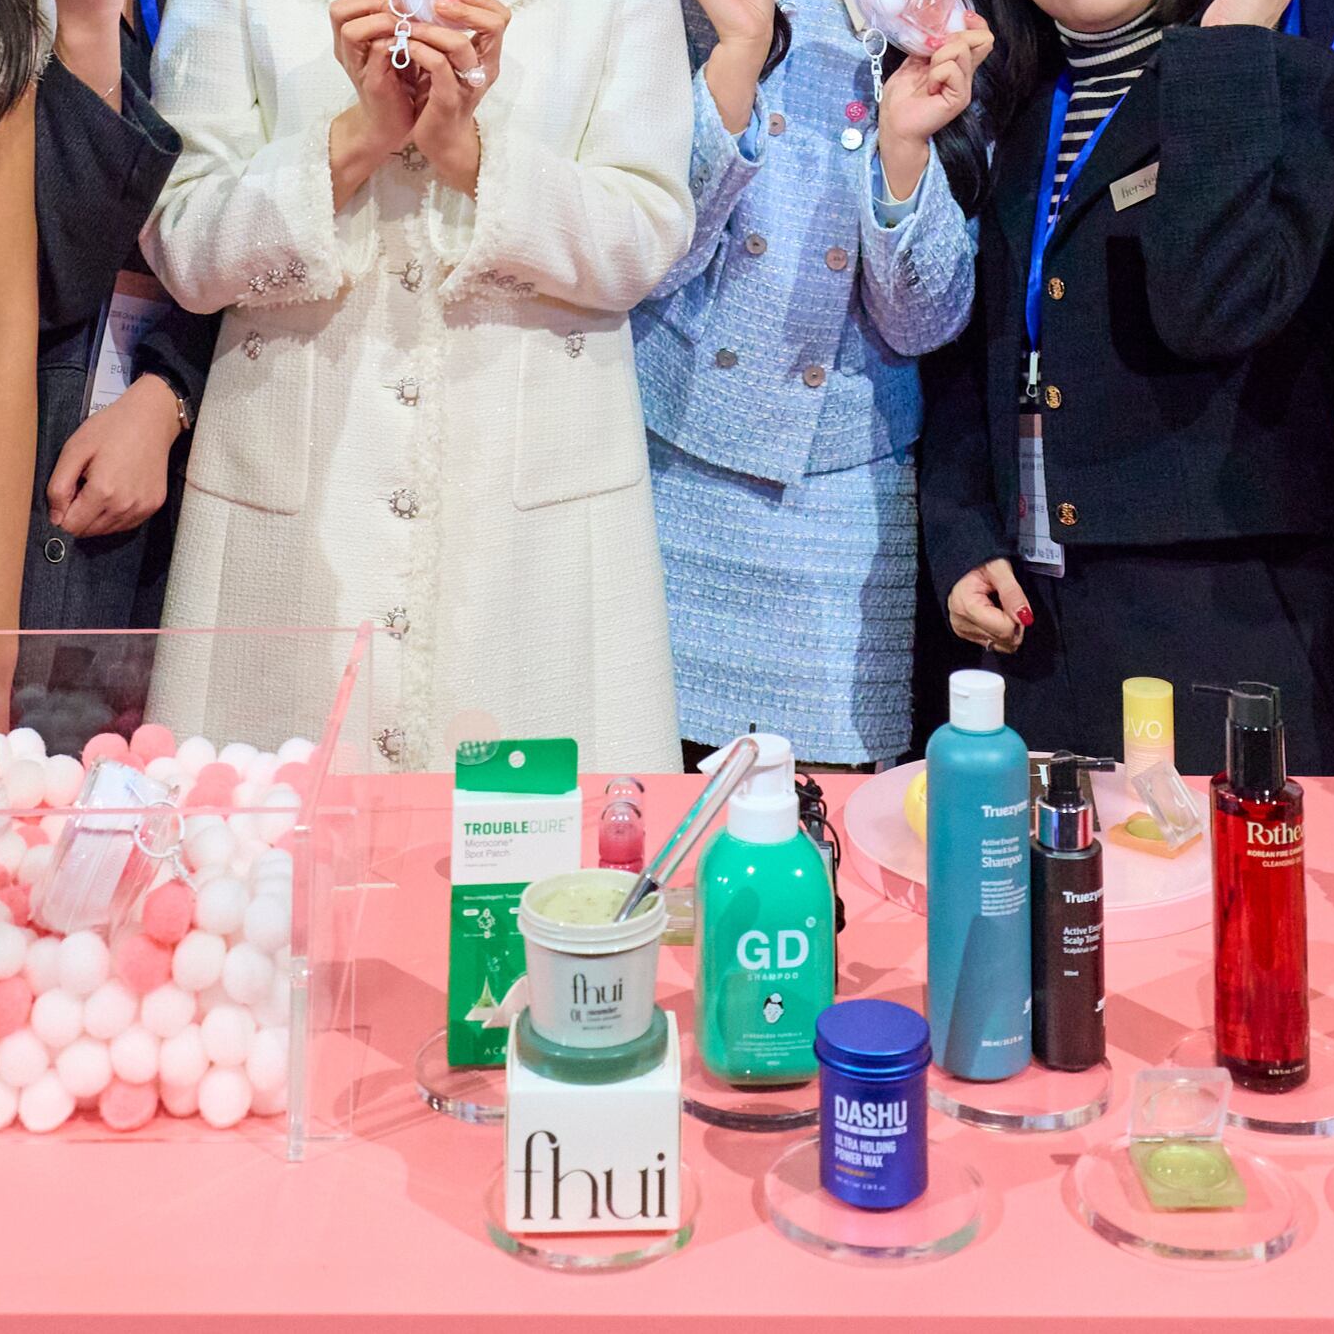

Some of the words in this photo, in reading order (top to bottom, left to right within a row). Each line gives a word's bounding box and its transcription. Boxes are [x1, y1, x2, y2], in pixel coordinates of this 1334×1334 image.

[982, 854, 1022, 868] Shampoo
[1063, 926, 1087, 936] Active
[1063, 936, 1085, 946] Scalp
[736, 930, 809, 970] GD
[747, 972, 799, 981] SHAMPOO
[572, 973, 623, 1004] fhui
[835, 1094, 907, 1128] DASHU
[835, 1132, 859, 1151] ULTRA
[859, 1140, 897, 1155] HOLDING
[835, 1146, 862, 1166] POWER
[863, 1155, 884, 1168] WAX
[514, 1130, 667, 1220] fhui
